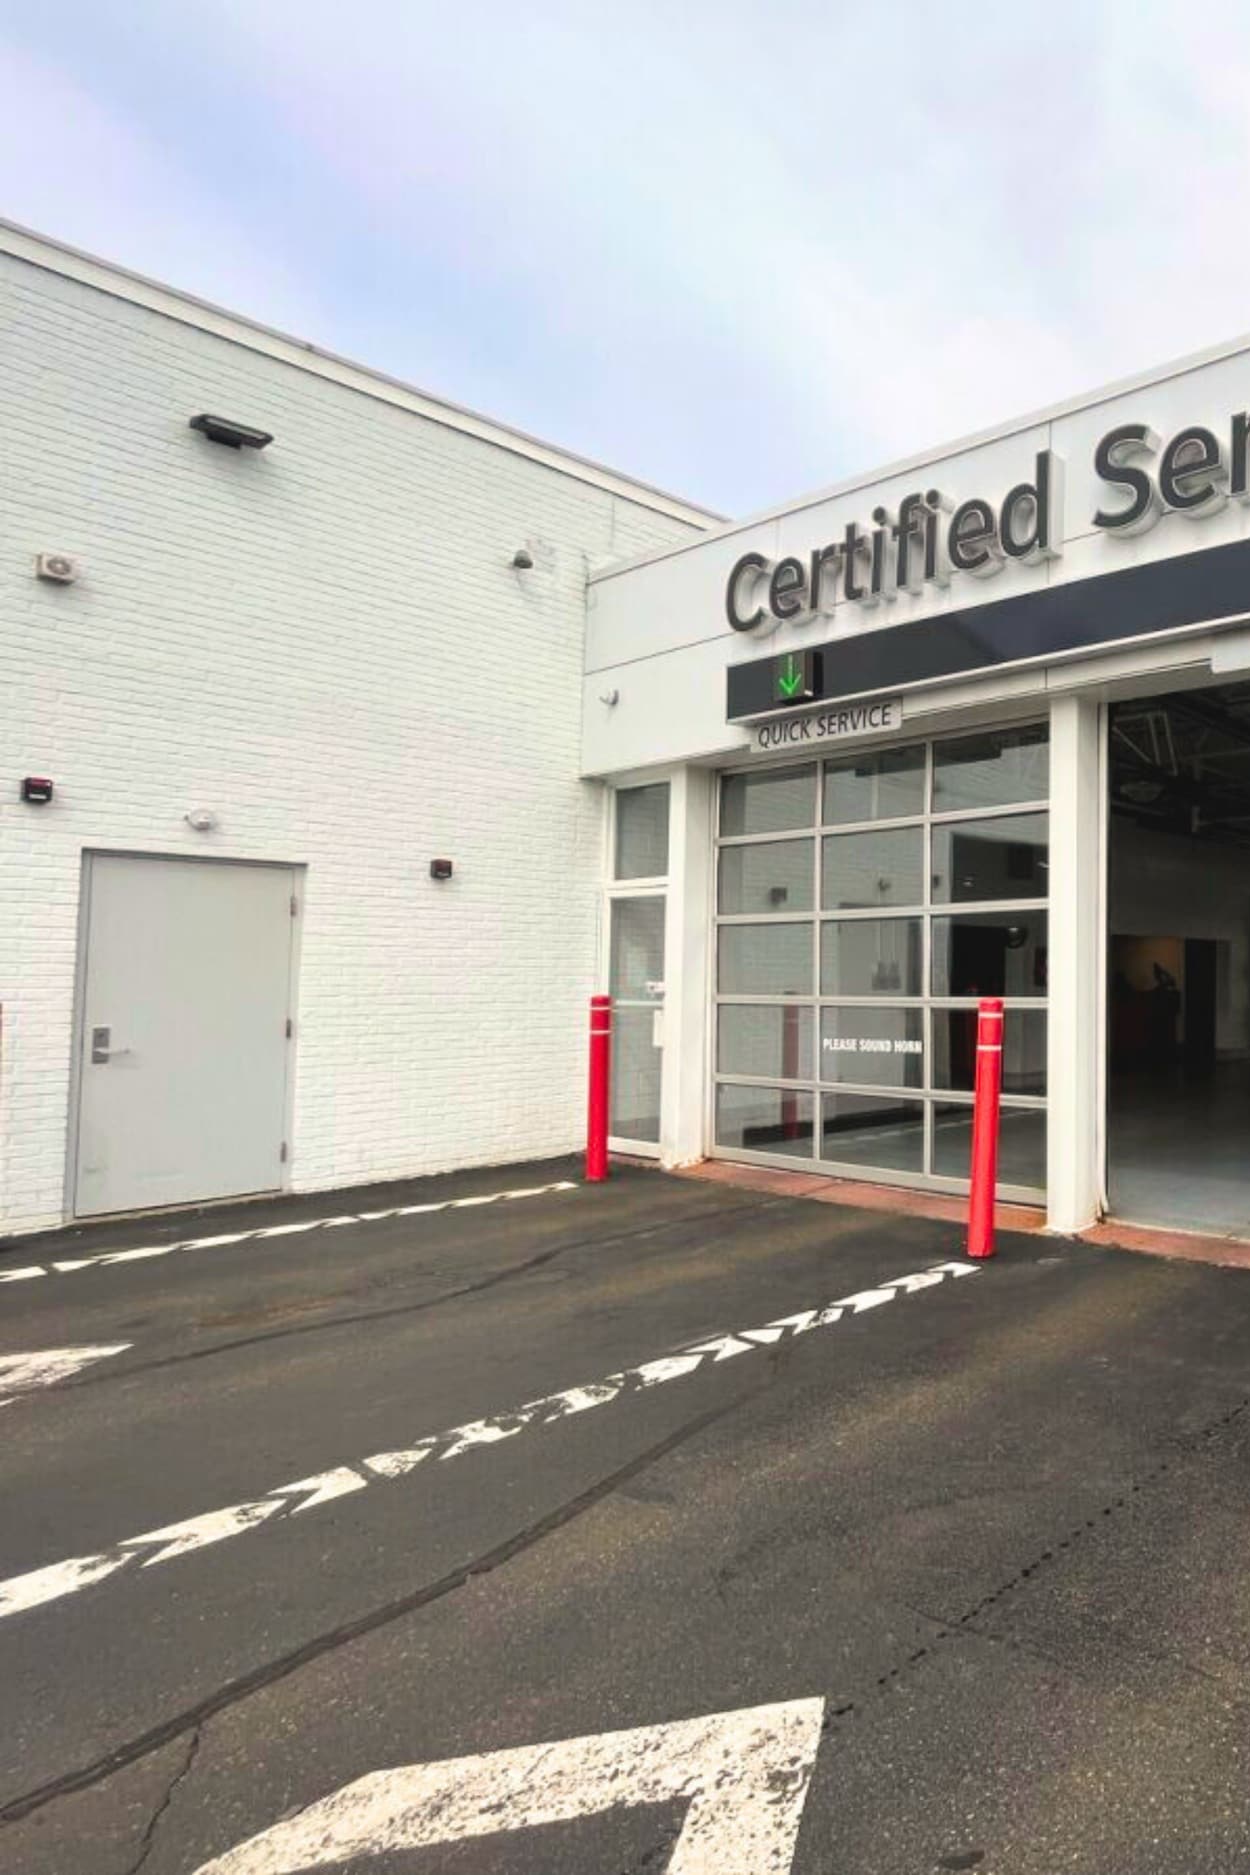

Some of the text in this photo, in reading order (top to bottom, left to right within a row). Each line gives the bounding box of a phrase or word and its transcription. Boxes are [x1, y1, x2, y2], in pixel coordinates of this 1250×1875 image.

[726, 450, 1056, 632] Certified
[758, 704, 892, 747] QUICK SERVICE
[823, 1037, 923, 1054] PLEASE SOUND HORN
